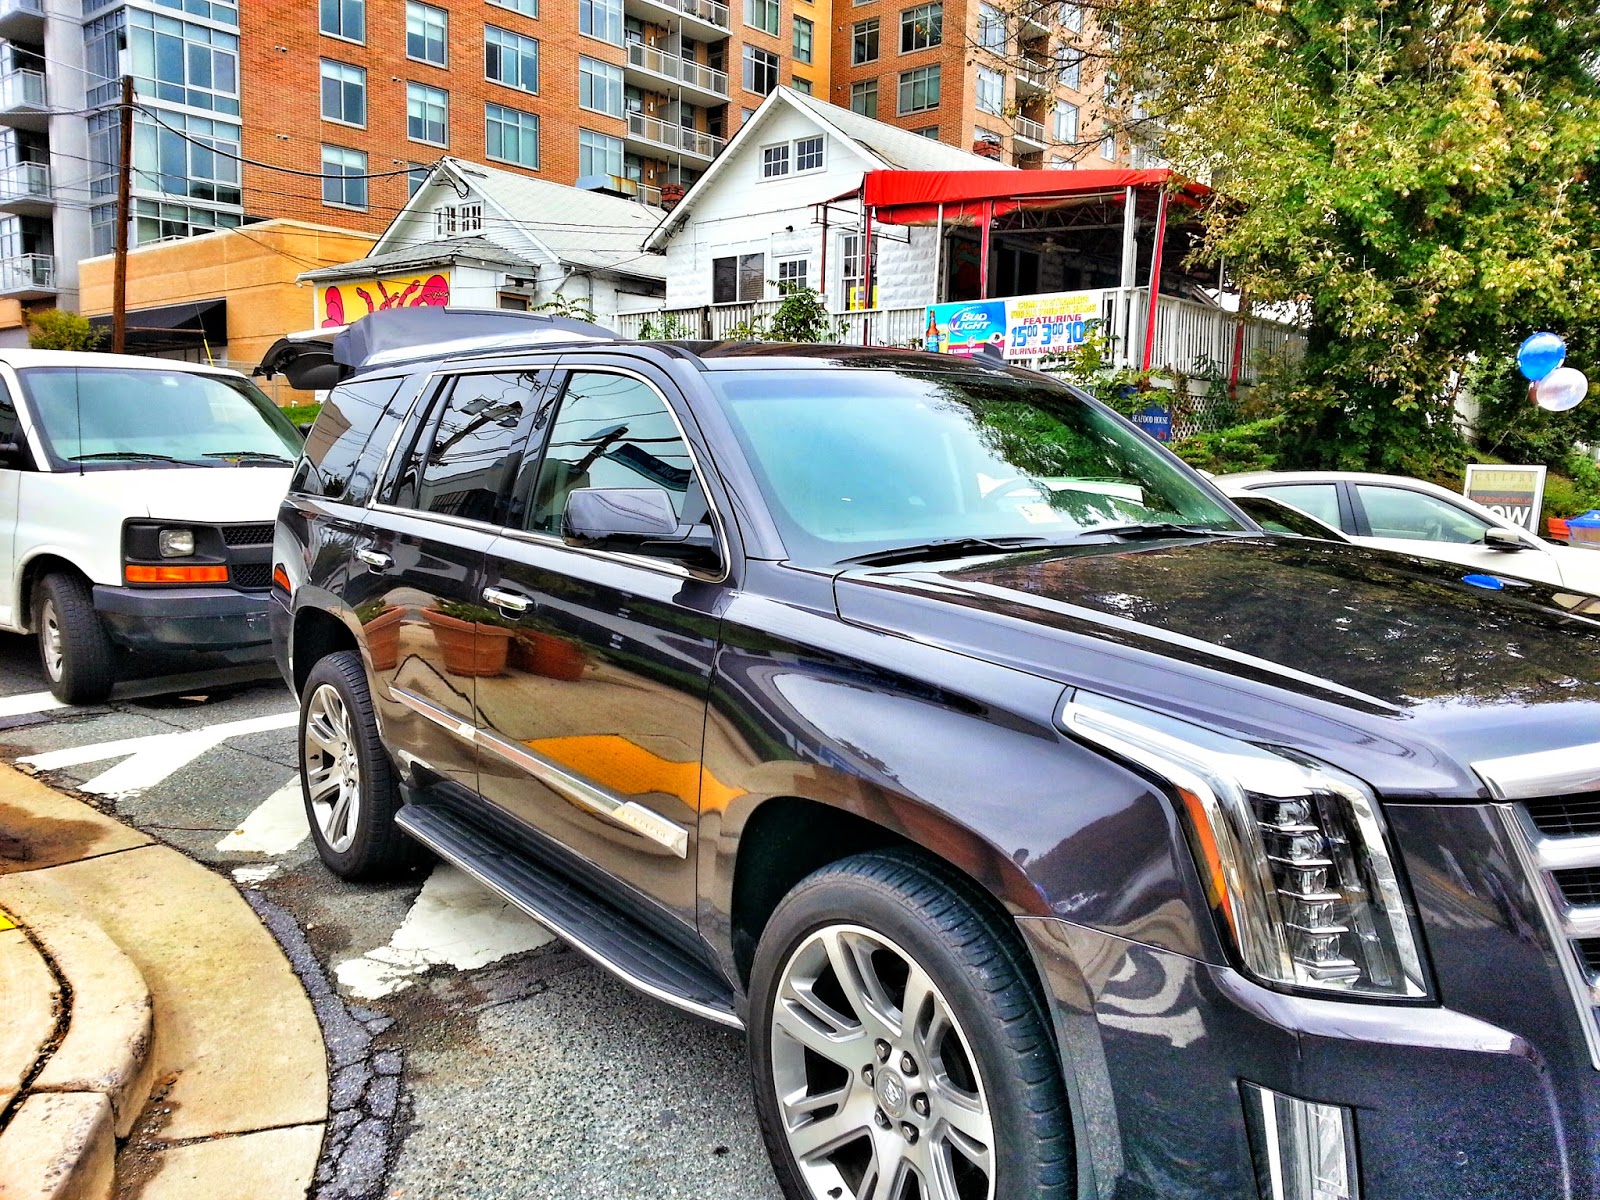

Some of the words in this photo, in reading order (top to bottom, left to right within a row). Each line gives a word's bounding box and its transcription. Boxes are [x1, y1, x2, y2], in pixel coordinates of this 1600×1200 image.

[961, 312, 988, 321] BUD
[1023, 314, 1082, 325] FEATURING
[955, 321, 991, 330] LIGHT
[1131, 414, 1153, 424] SEAFOOD
[1154, 416, 1168, 425] HOUSE
[1475, 473, 1536, 482] GALLERY
